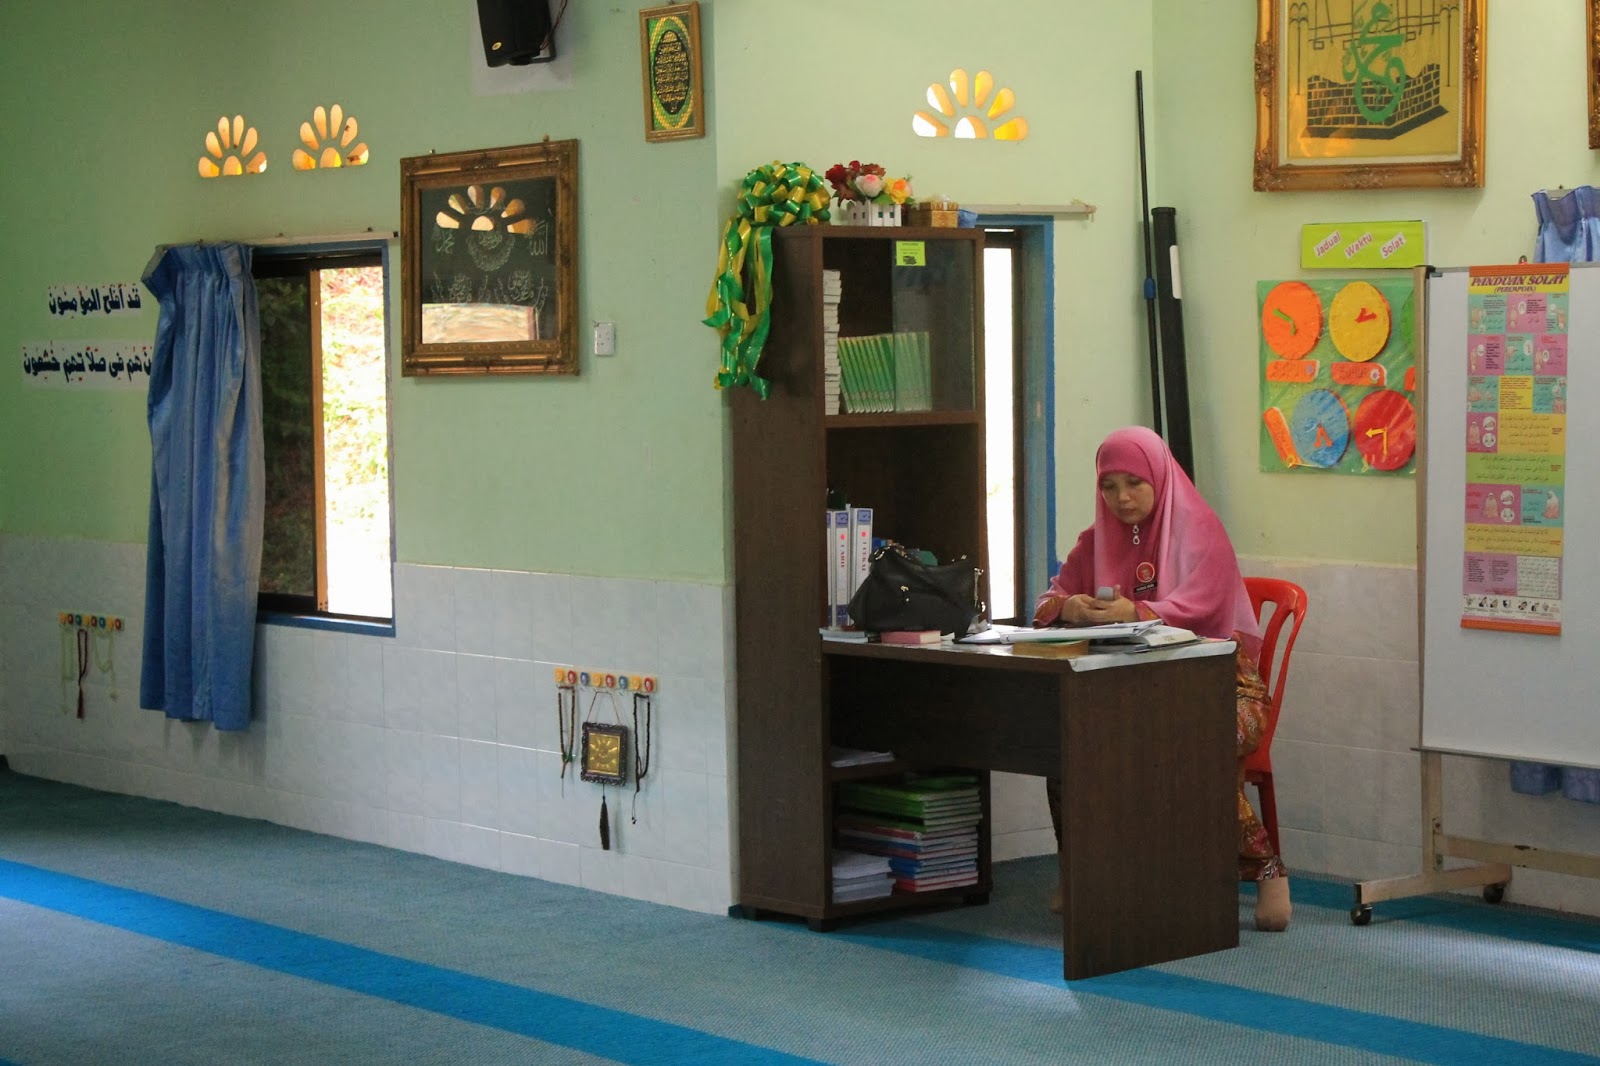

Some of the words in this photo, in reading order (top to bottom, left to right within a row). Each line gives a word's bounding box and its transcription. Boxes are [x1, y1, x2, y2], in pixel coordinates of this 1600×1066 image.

[1315, 231, 1341, 256] Jadual
[1345, 234, 1372, 257] Waktu
[1382, 237, 1404, 257] Solat
[1471, 276, 1527, 287] PANDUAN
[1527, 275, 1567, 285] SOLAT
